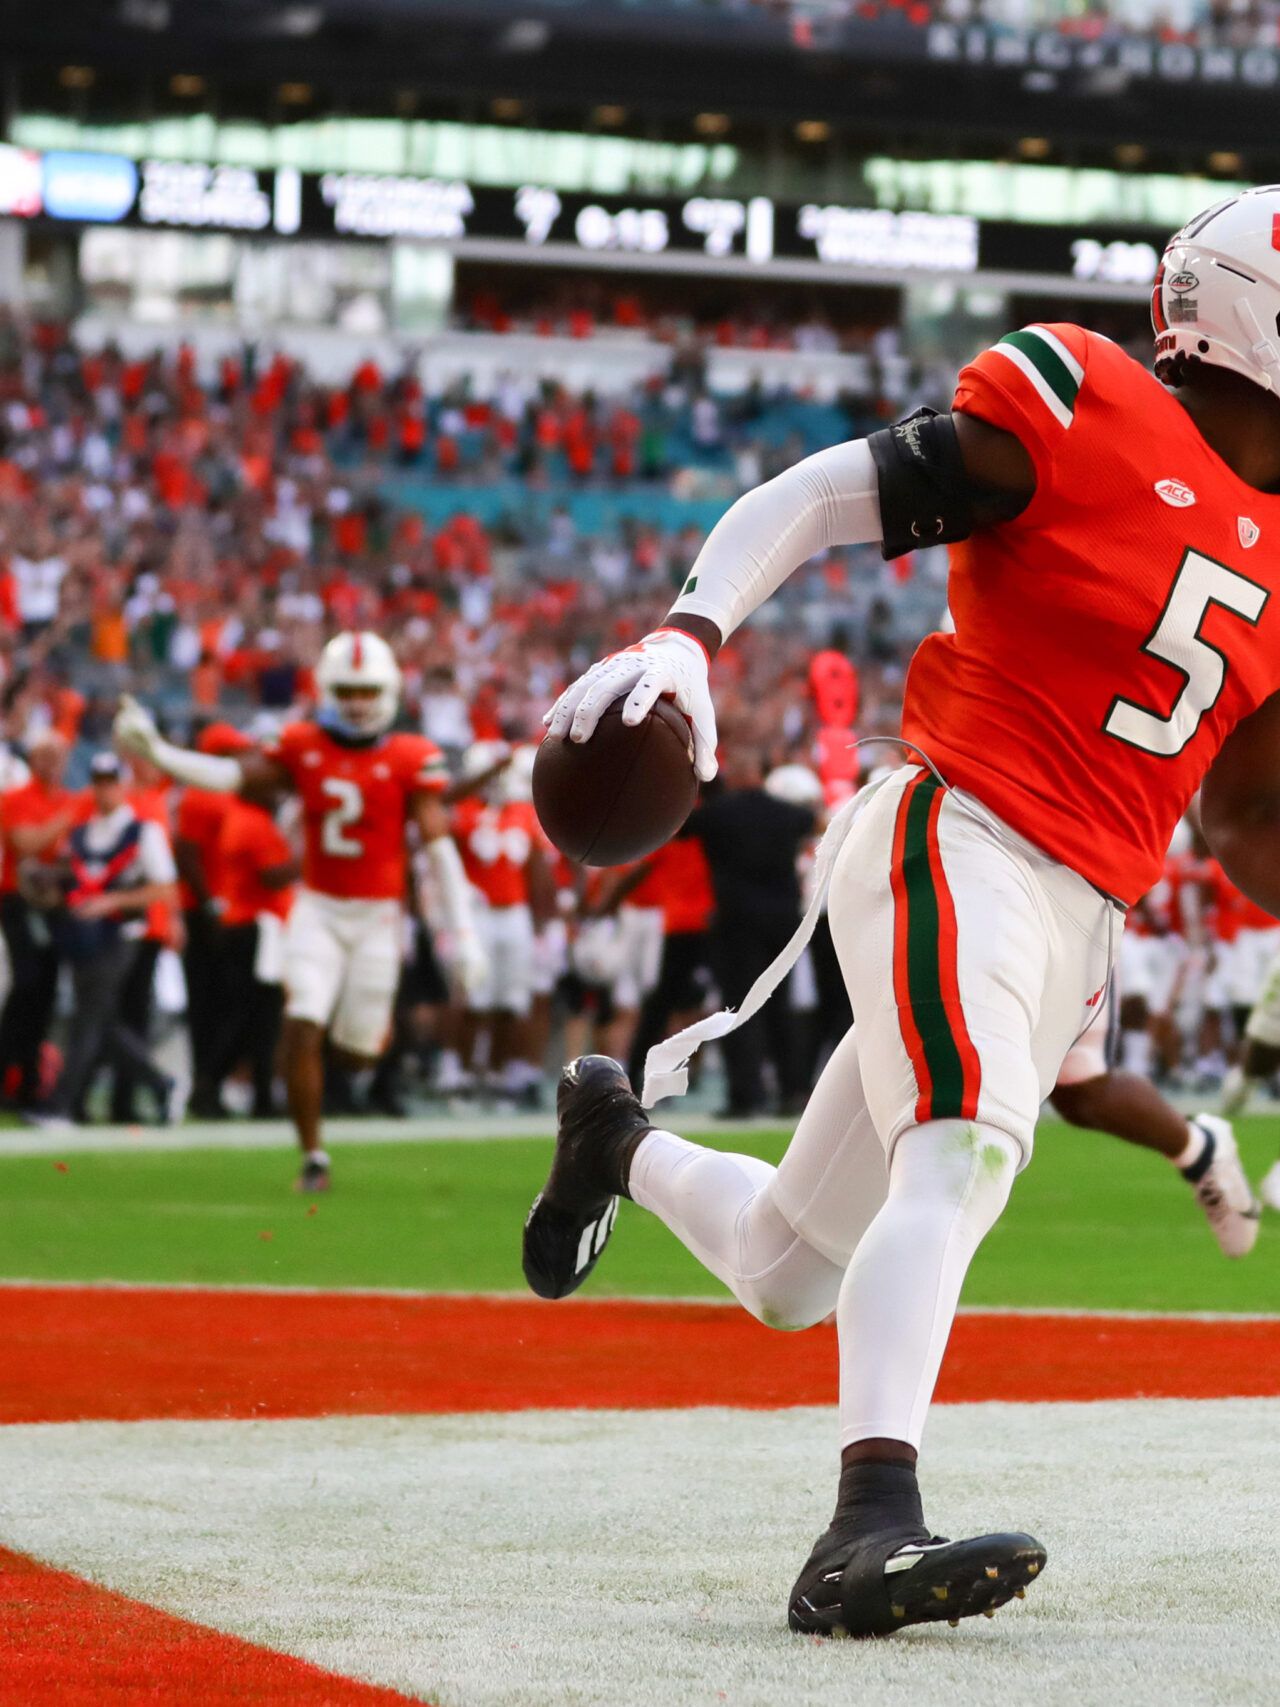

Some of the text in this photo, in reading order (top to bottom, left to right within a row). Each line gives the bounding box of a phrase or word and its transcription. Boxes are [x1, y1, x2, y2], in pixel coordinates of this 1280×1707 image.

[1171, 275, 1194, 286] ACC
[1159, 484, 1190, 503] ACC
[1101, 545, 1272, 758] 5
[319, 776, 364, 859] 2
